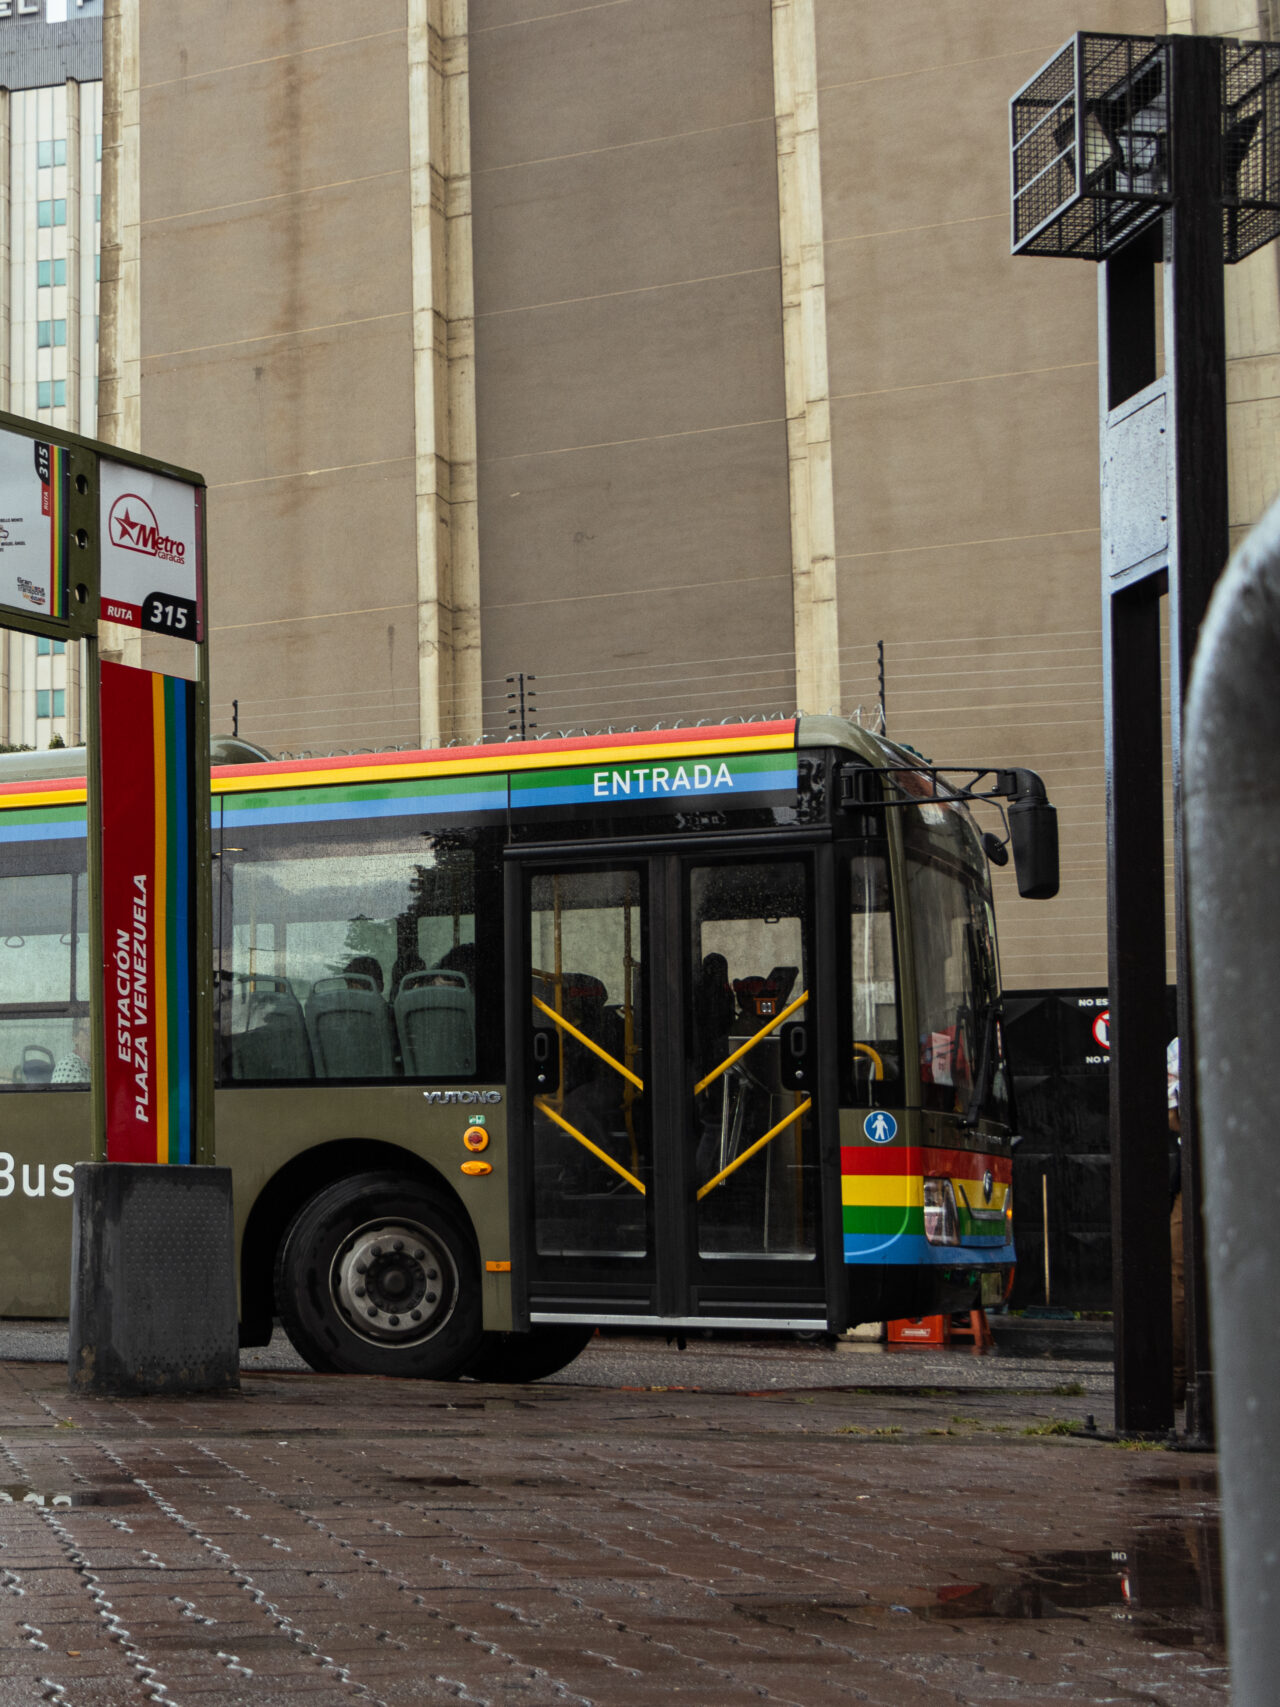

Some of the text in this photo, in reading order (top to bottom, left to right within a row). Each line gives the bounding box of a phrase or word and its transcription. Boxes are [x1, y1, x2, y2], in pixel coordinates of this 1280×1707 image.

[39, 446, 49, 478] 315
[136, 524, 185, 556] Metro
[158, 550, 185, 565] caracas
[107, 601, 188, 629] RUTA 315
[594, 763, 734, 797] ENTRADA
[112, 928, 132, 1063] ESTACIÓN
[133, 874, 149, 1122] PLAZA VENEZUELA
[1078, 999, 1094, 1007] NO
[423, 1090, 501, 1104] YUTONG
